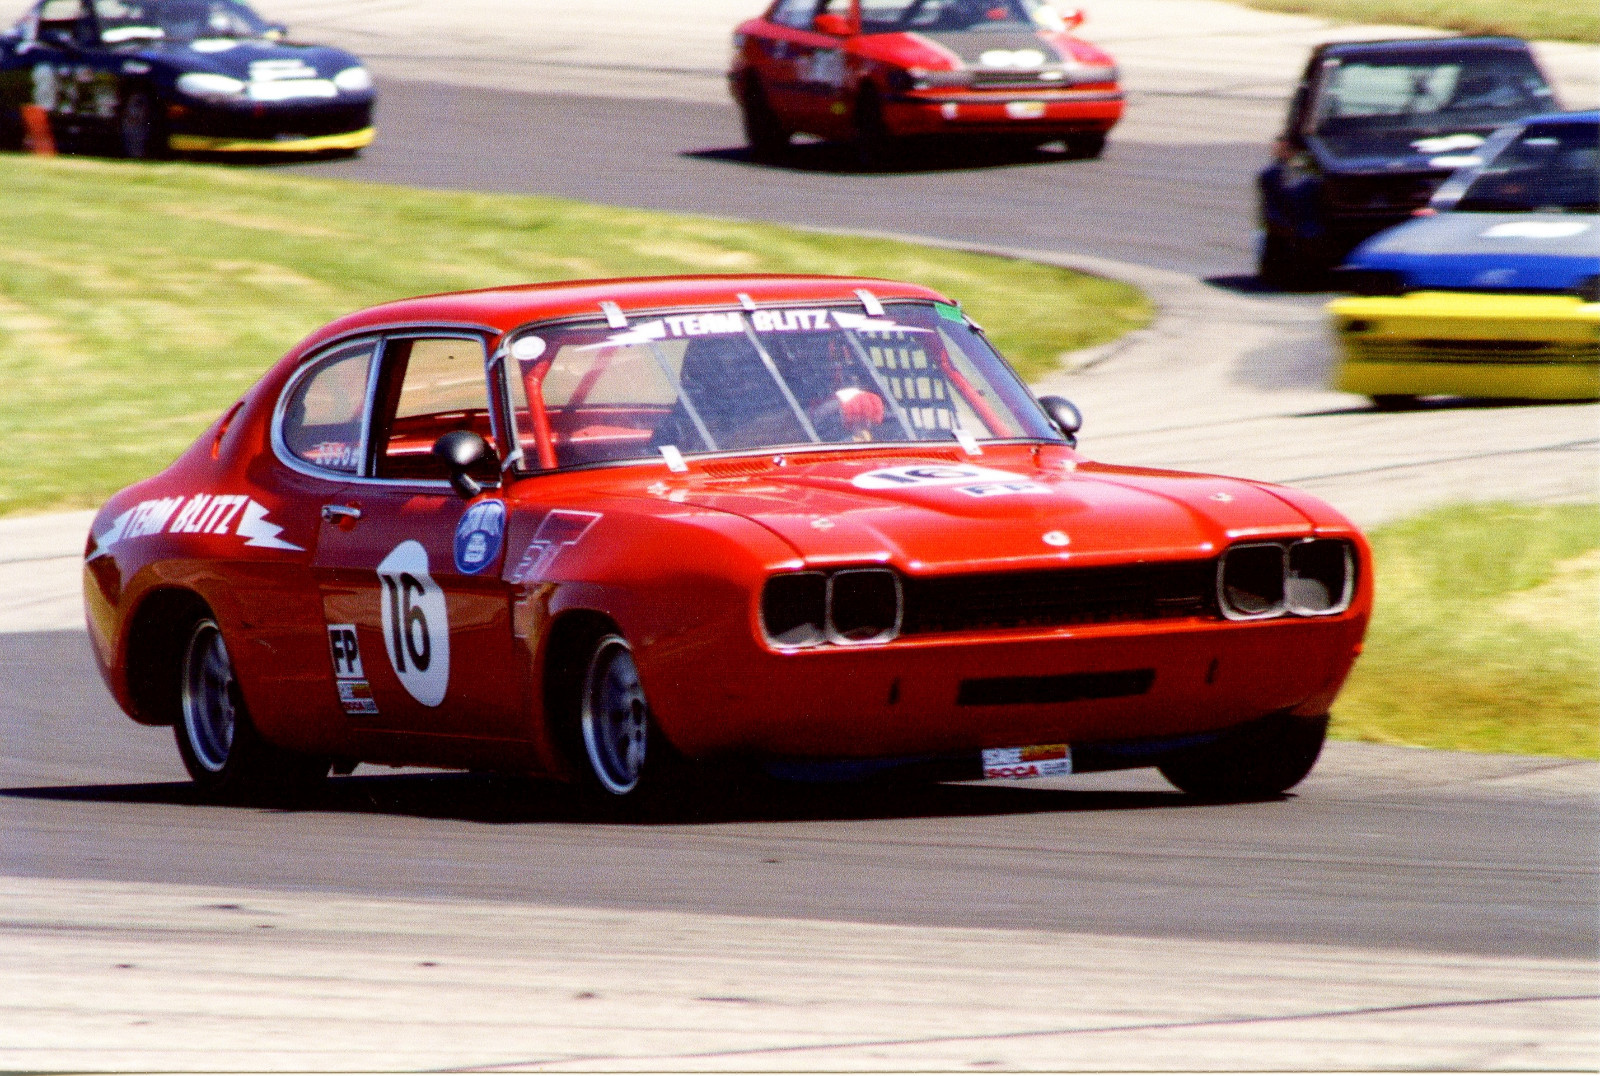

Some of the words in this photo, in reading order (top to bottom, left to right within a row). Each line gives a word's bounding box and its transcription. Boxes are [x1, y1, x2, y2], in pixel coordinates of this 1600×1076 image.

[663, 311, 744, 337] TEAM
[751, 309, 831, 331] BLITZ
[122, 496, 184, 539] TEAM
[168, 492, 250, 534] BLITZ
[382, 572, 431, 674] 16
[330, 629, 359, 674] FP
[985, 765, 1038, 778] SCCA
